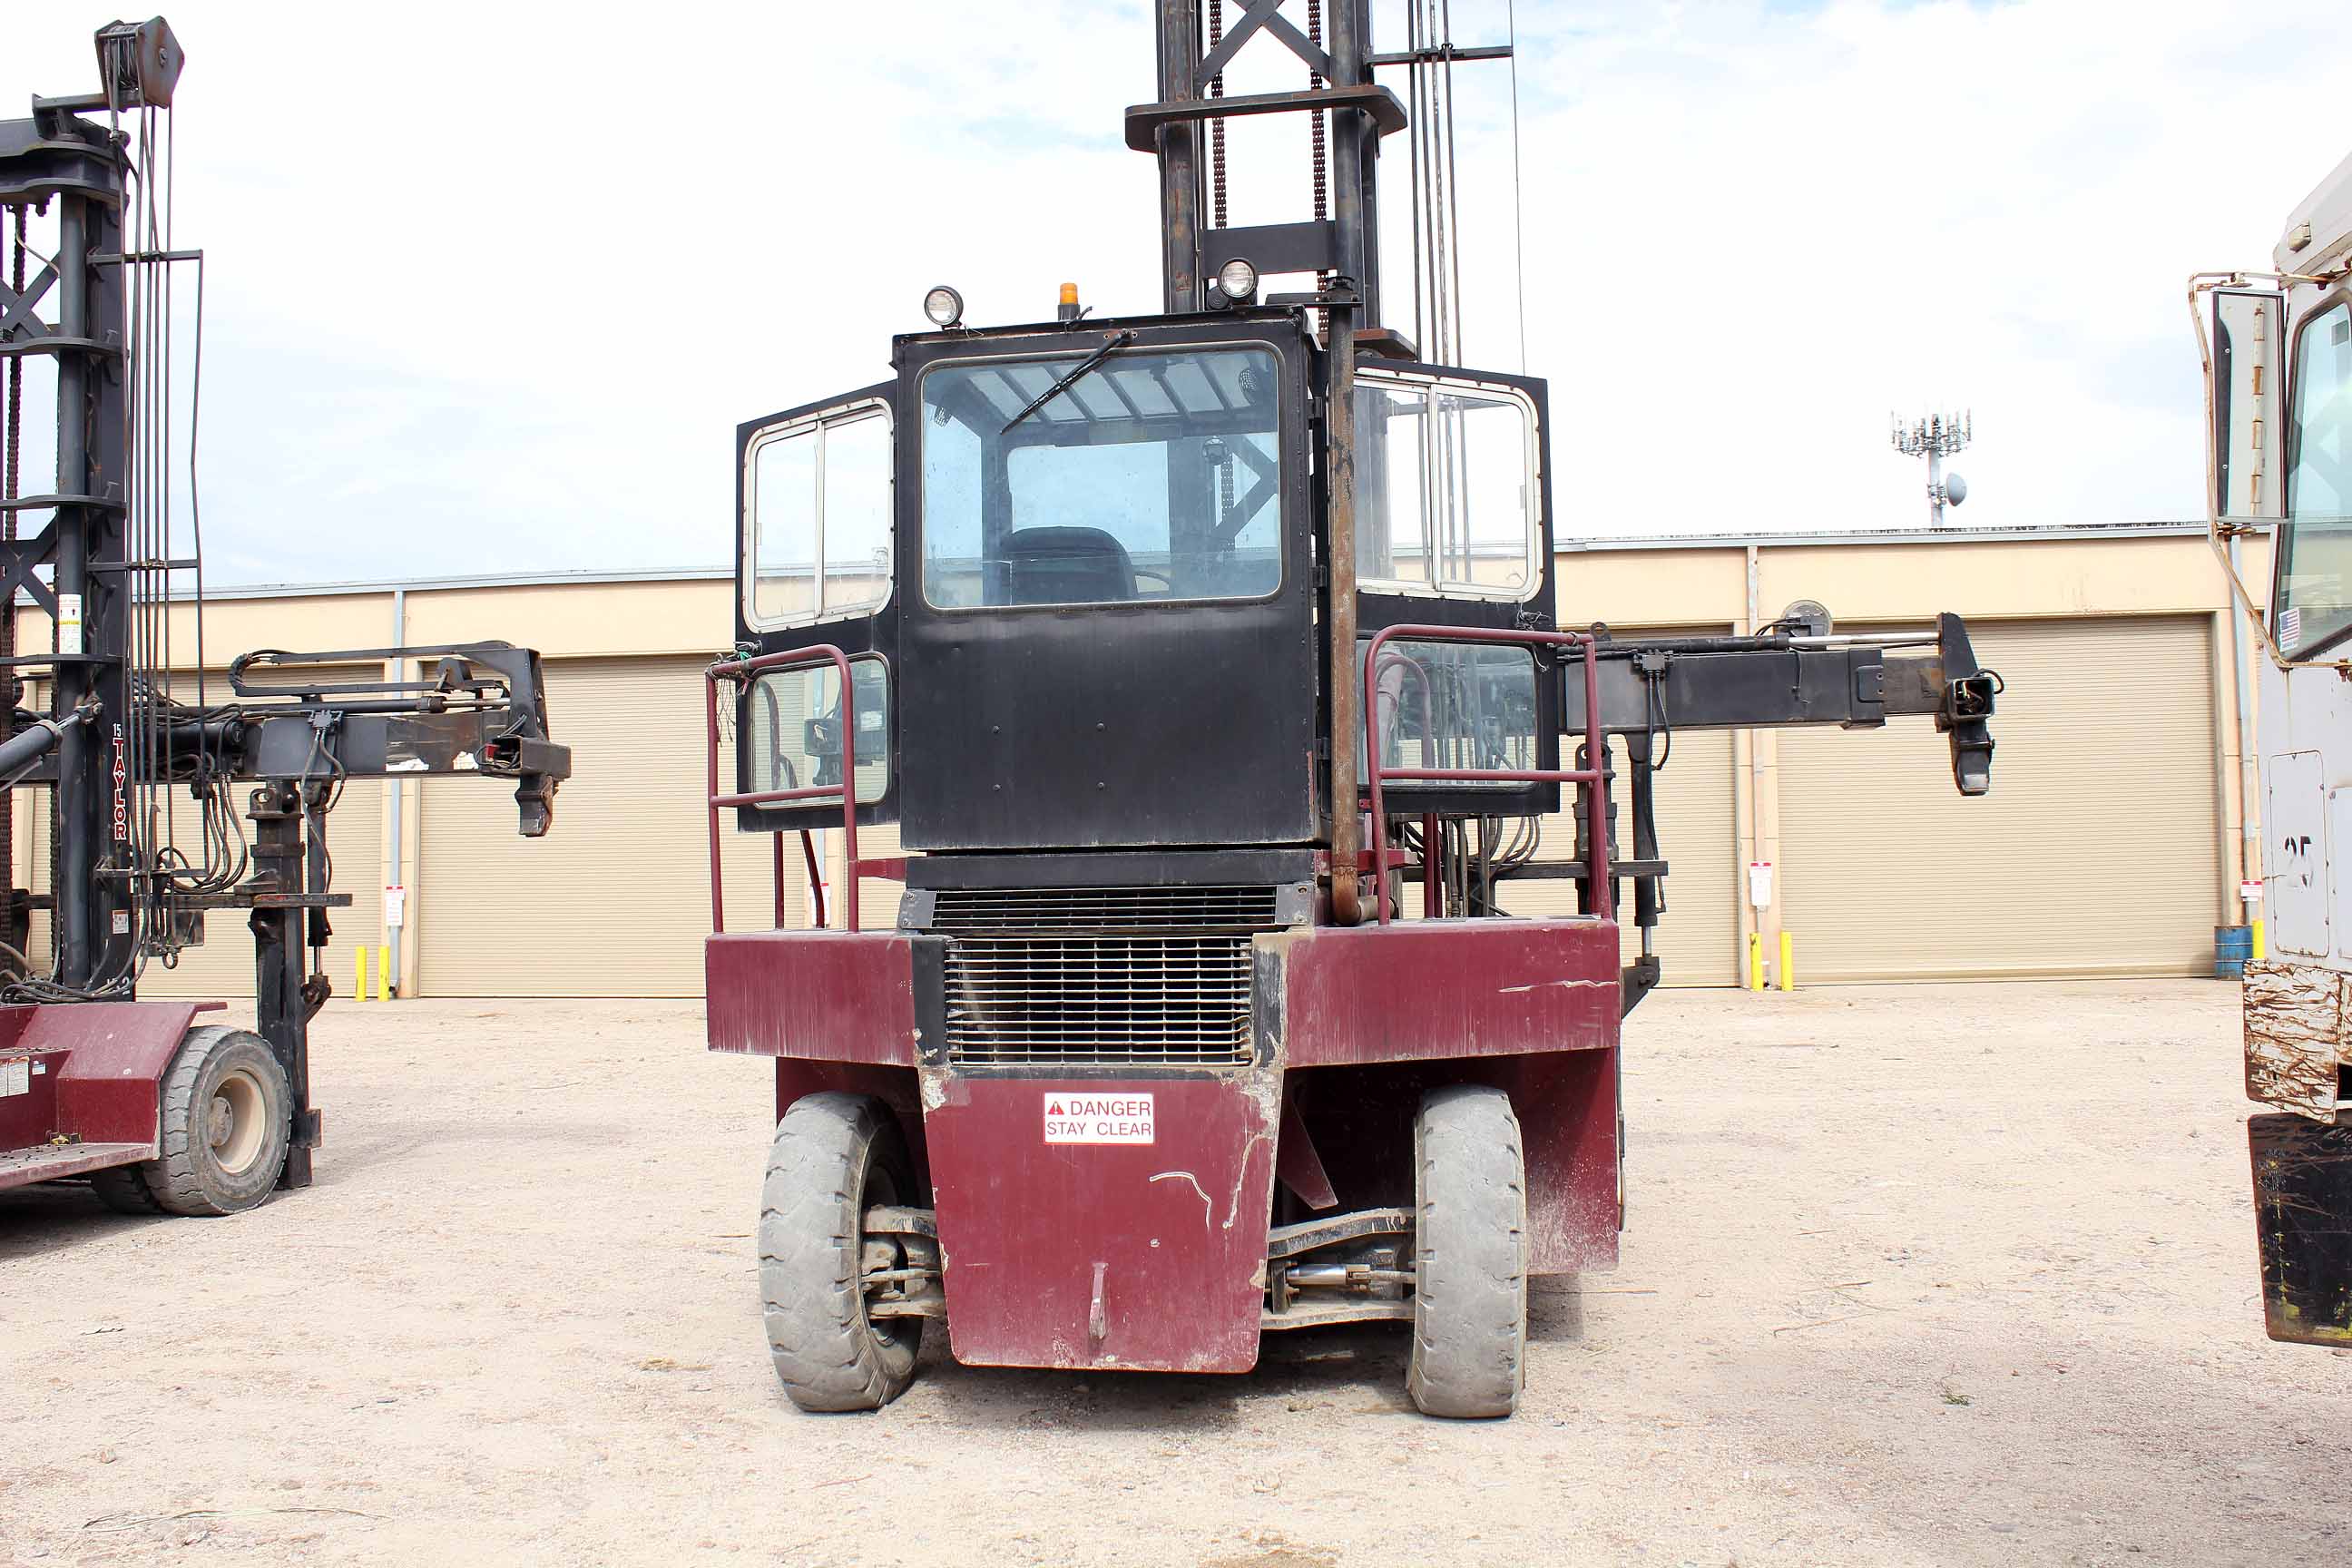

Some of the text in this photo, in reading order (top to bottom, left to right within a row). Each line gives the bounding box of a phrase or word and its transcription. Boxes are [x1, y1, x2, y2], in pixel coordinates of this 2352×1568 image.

[113, 738, 126, 840] TAYLOR
[1070, 1101, 1151, 1116] DANGER
[1046, 1122, 1152, 1136] STAY CLEAR
